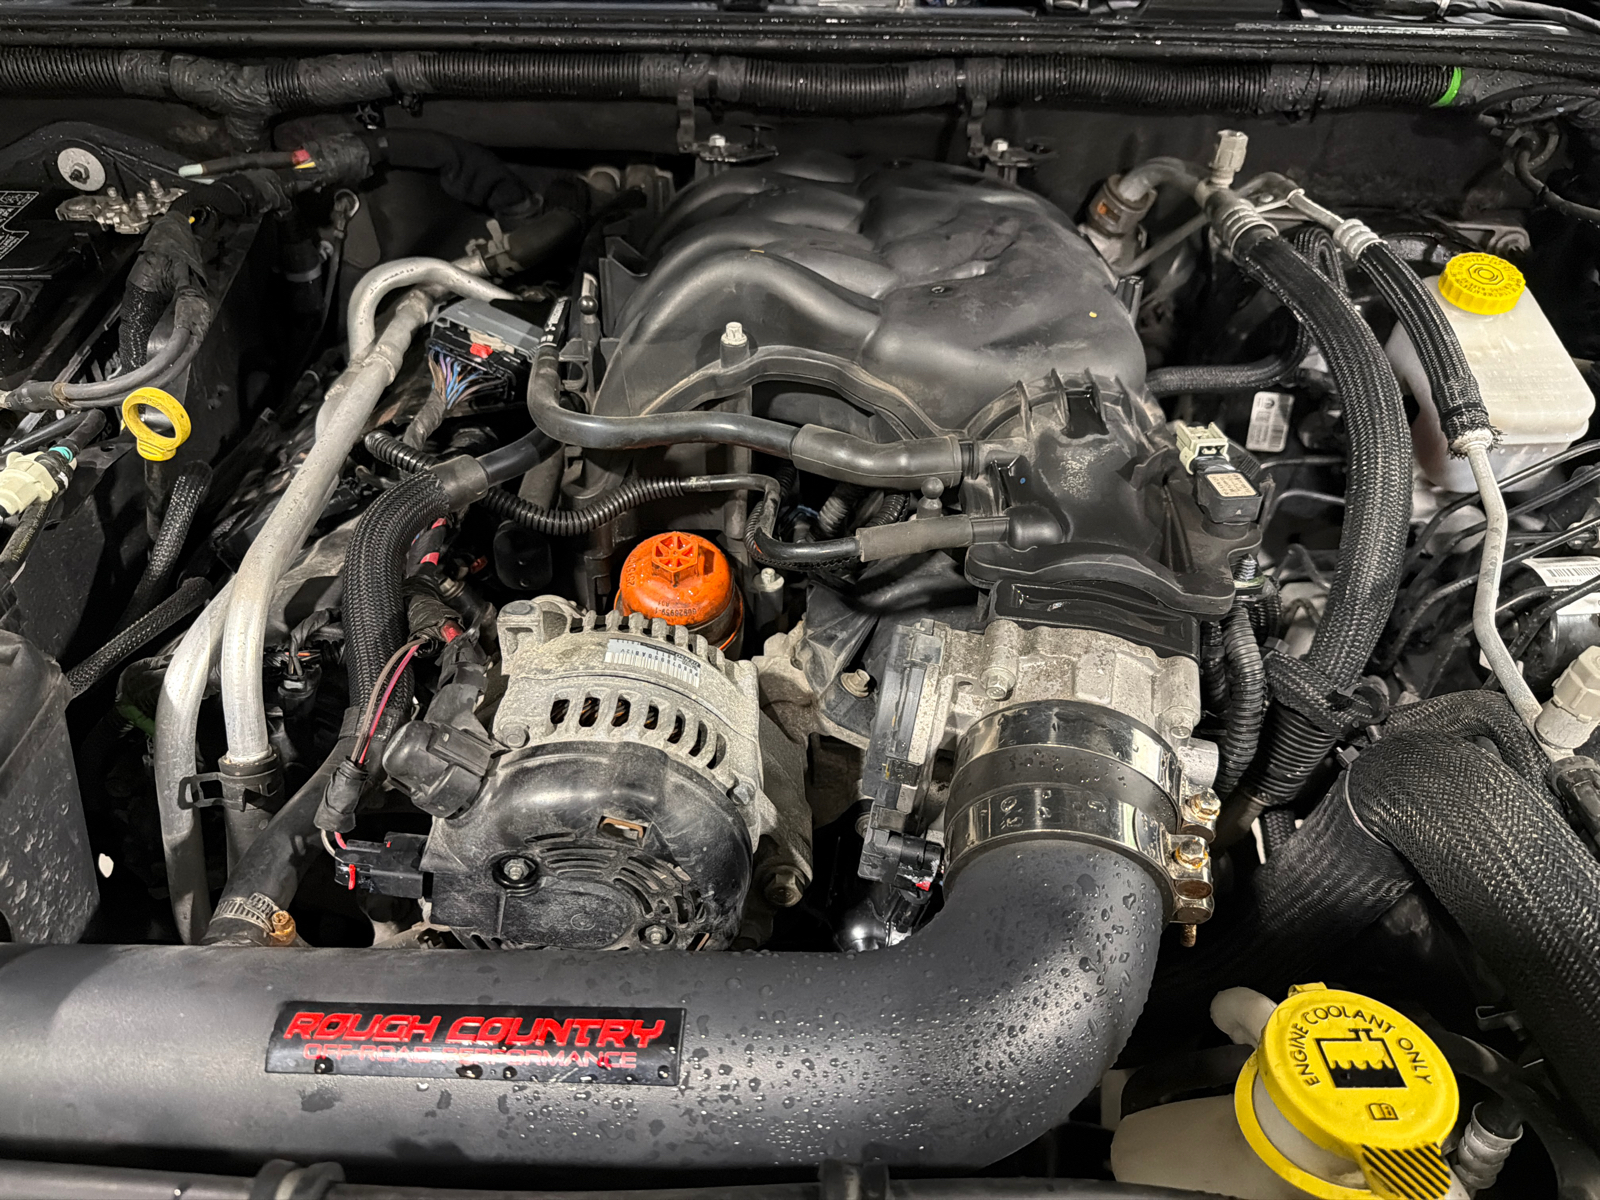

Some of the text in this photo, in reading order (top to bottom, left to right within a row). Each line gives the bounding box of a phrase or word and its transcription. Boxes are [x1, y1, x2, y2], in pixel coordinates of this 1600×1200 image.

[283, 1012, 666, 1048] ROUGH COUNTRY
[1289, 1004, 1434, 1087] ENGINE COOLANT ONLY
[303, 1043, 657, 1069] OFF-ROAD PERFORMANCE
